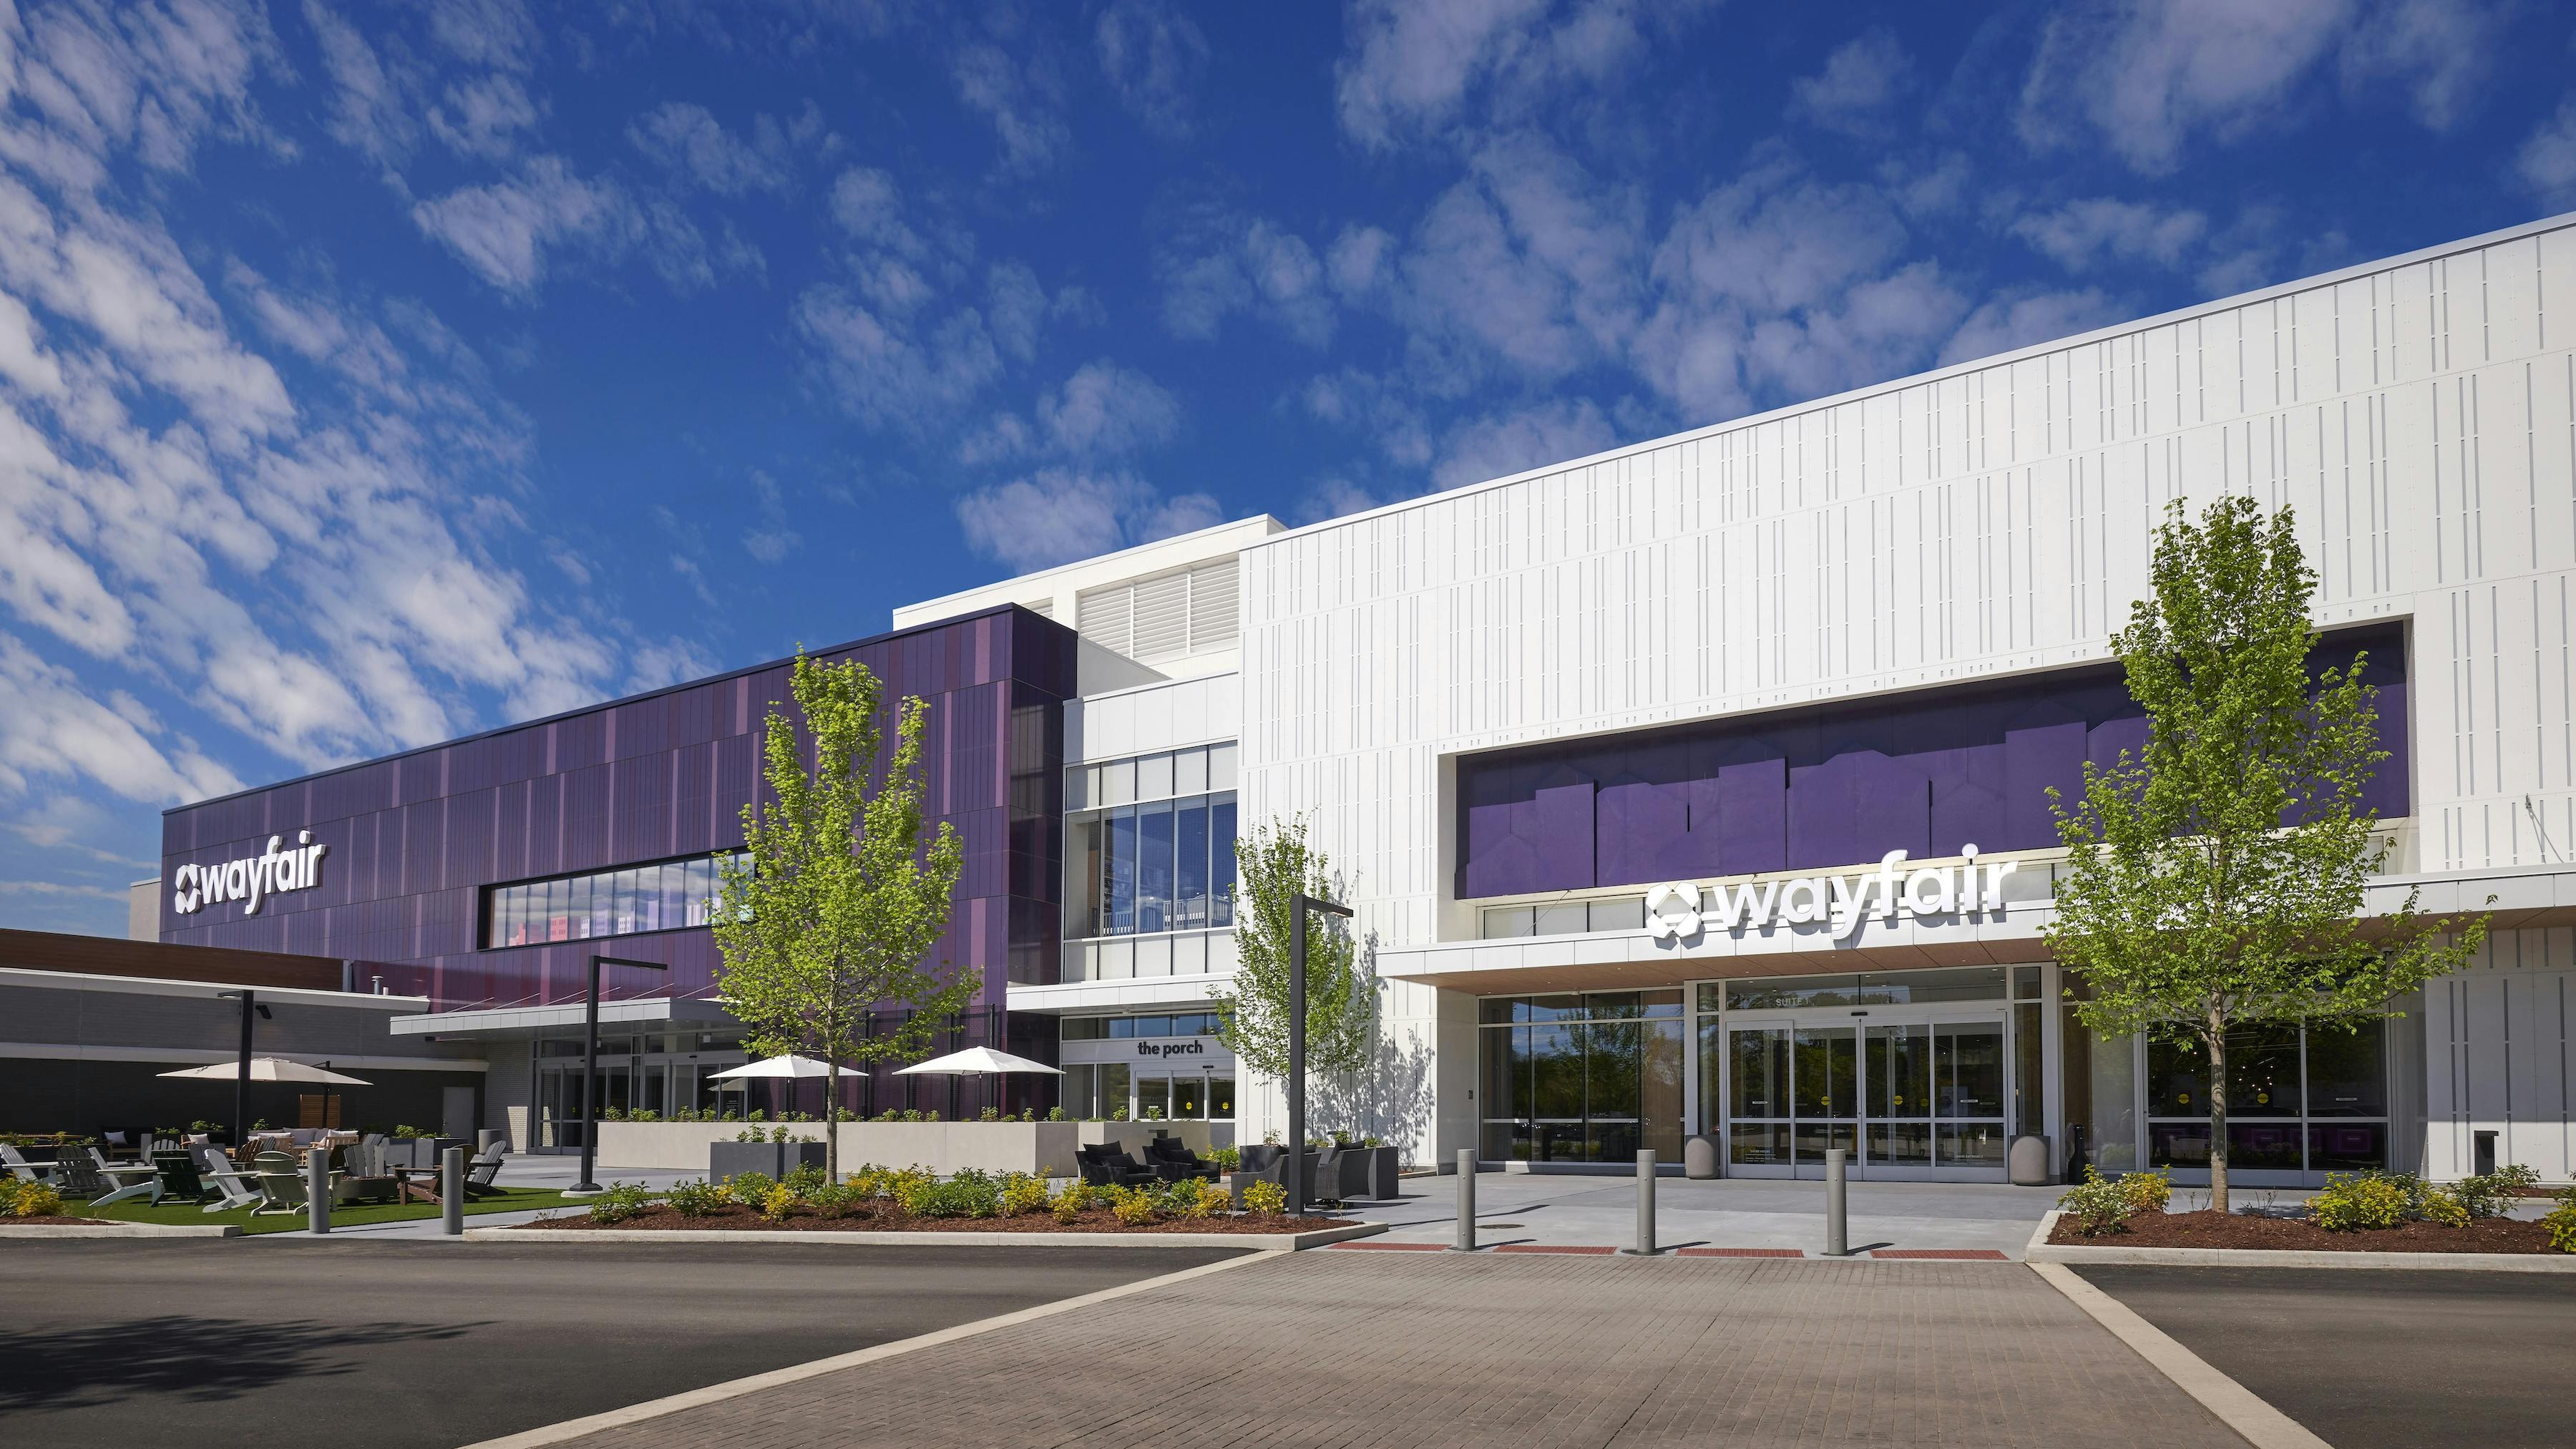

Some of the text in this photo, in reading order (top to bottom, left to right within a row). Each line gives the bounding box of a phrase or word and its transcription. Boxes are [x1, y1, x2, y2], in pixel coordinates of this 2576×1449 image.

[200, 829, 327, 914] wayfair
[1712, 843, 2019, 940] wayfair
[1775, 997, 1802, 1007] SUITE
[1138, 1040, 1204, 1058] the porch
